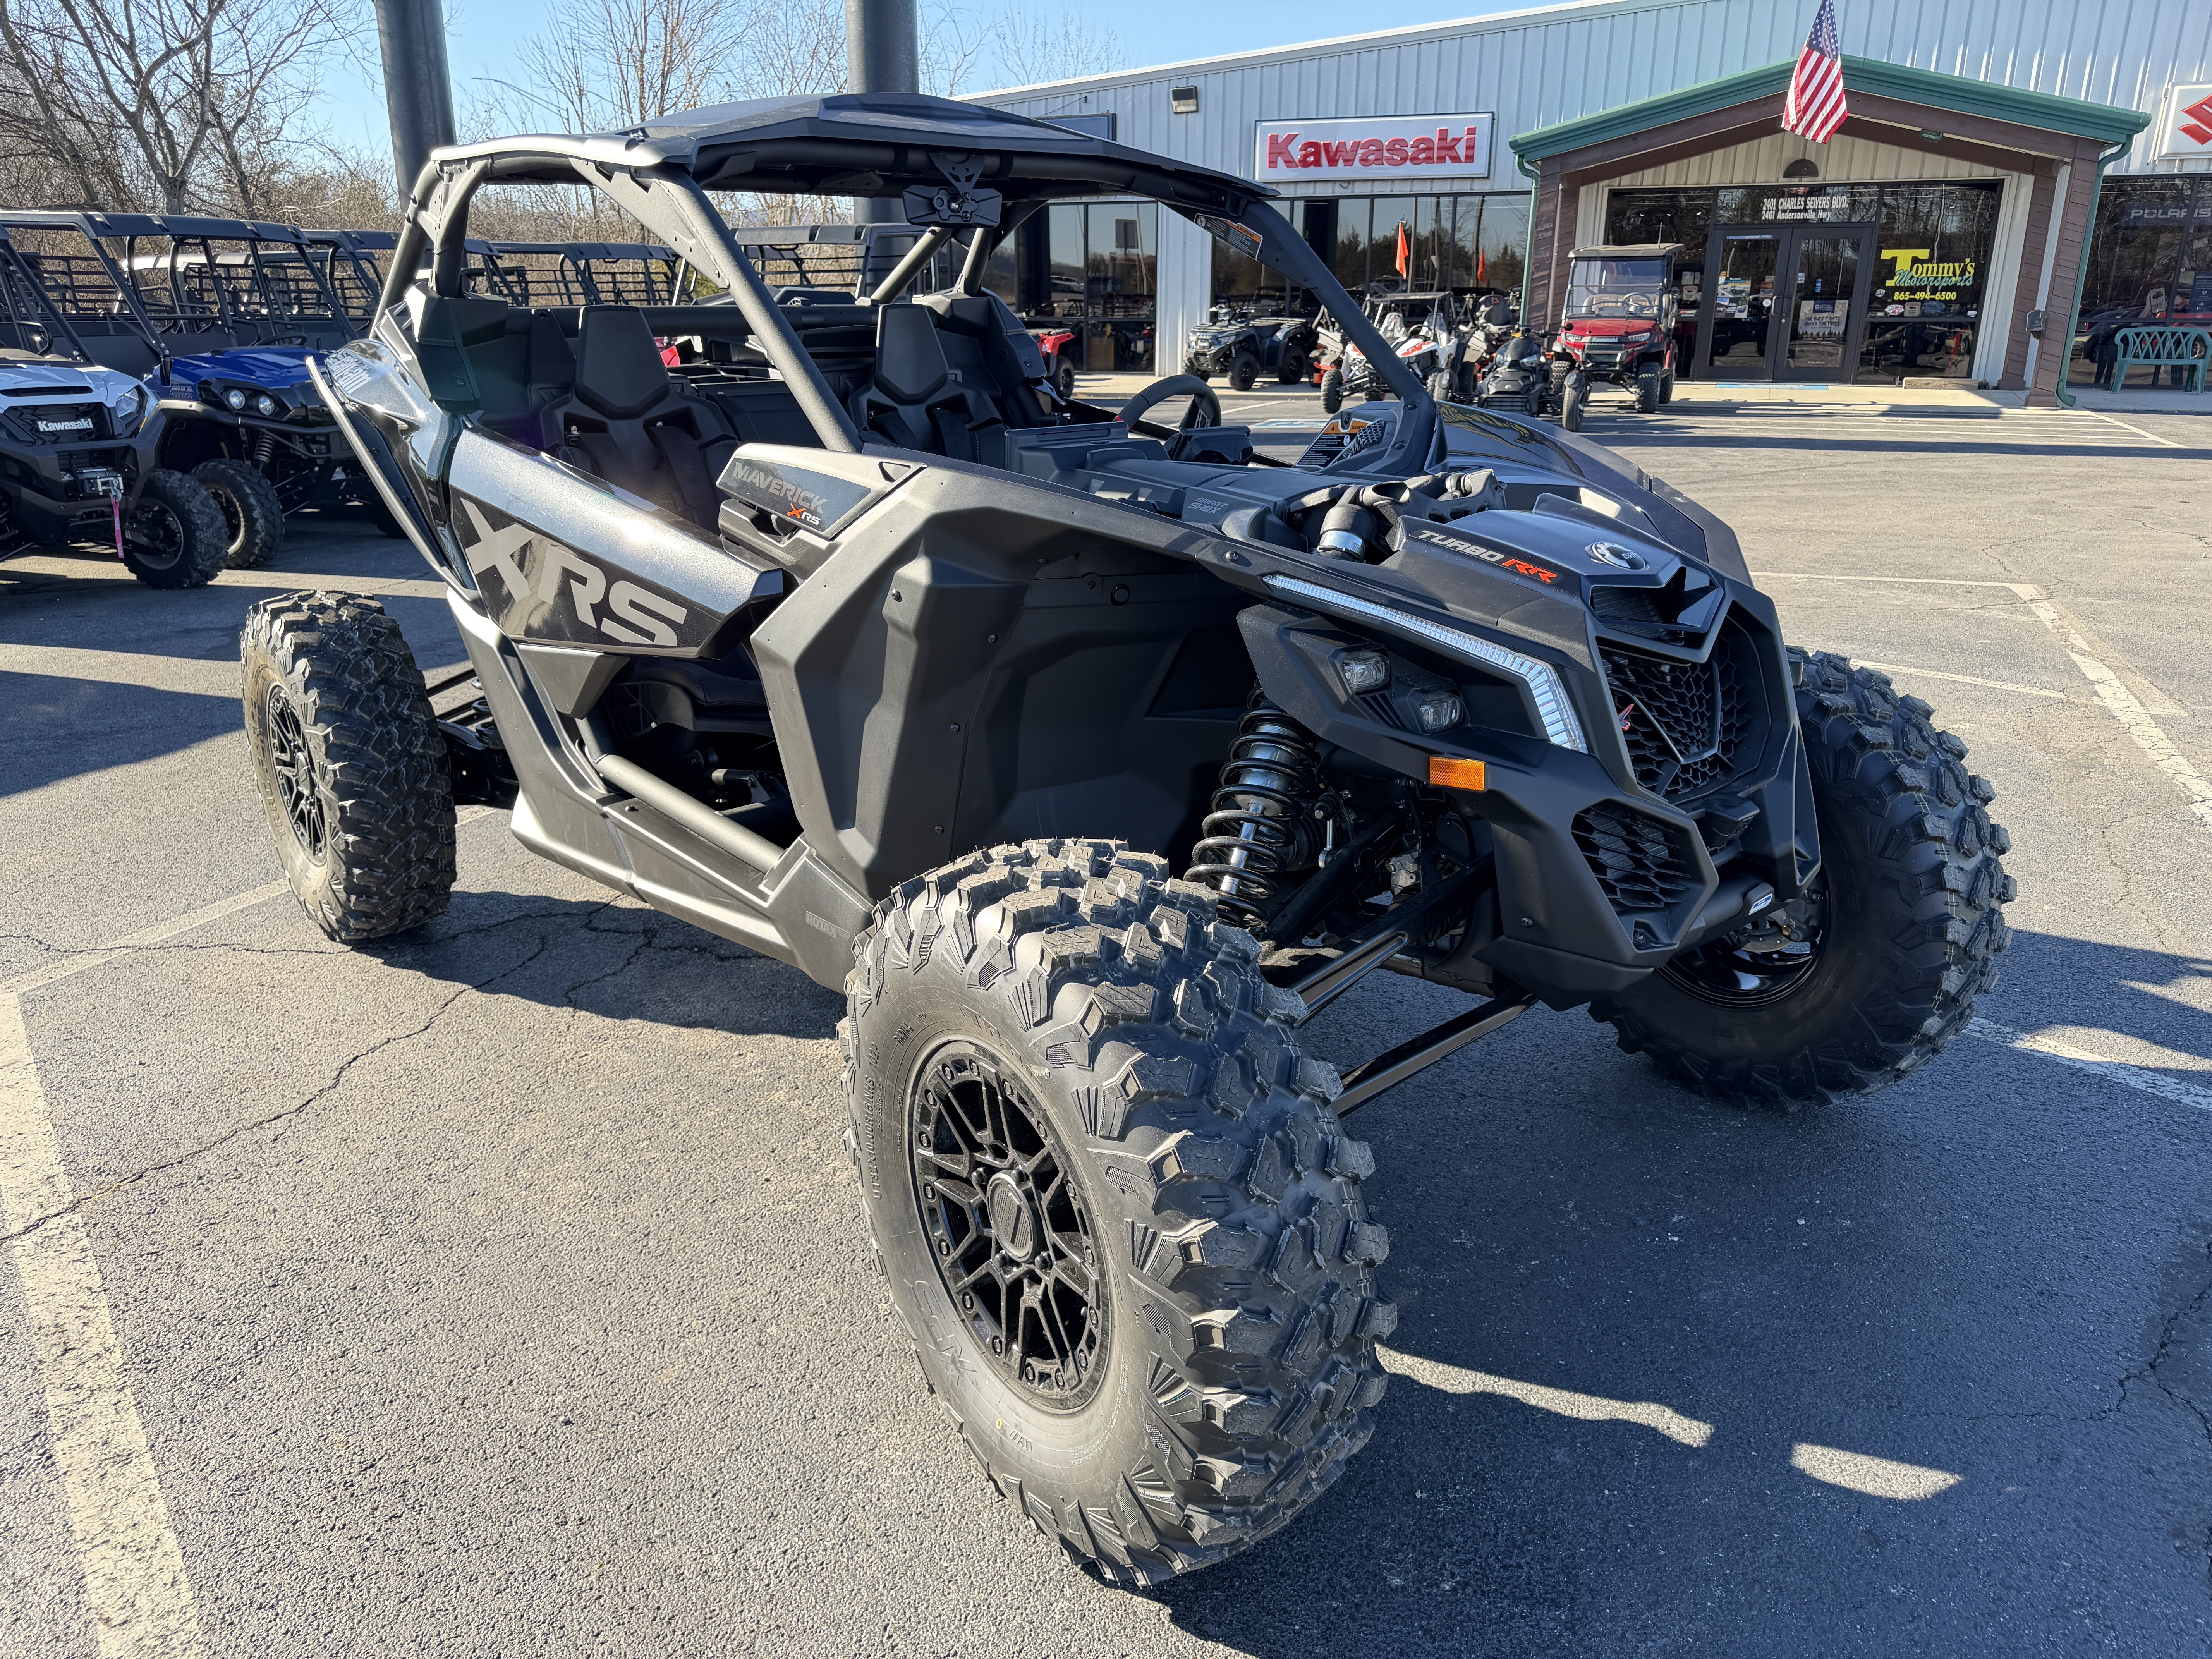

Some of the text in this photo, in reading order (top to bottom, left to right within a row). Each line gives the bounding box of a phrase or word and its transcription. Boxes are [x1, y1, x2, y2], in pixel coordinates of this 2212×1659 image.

[1267, 126, 1477, 169] Kawasaki
[1763, 196, 1848, 210] 2401 CHARLES SEIVERS BLVD.
[1762, 209, 1832, 221] 2401 Andersonville Hwy.
[2130, 208, 2212, 218] POLARIS
[1881, 249, 1975, 286] Tommy's
[1895, 269, 1974, 290] Motorsports
[1894, 292, 1957, 300] 865-494-6500
[37, 418, 94, 432] Kawasaki
[732, 462, 829, 516] MAVERICK
[1187, 502, 1224, 514] SHOX
[1197, 497, 1229, 508] SMART
[1417, 530, 1559, 584] TURBO RR
[460, 498, 688, 646] XRS
[805, 913, 838, 939] ROTAX
